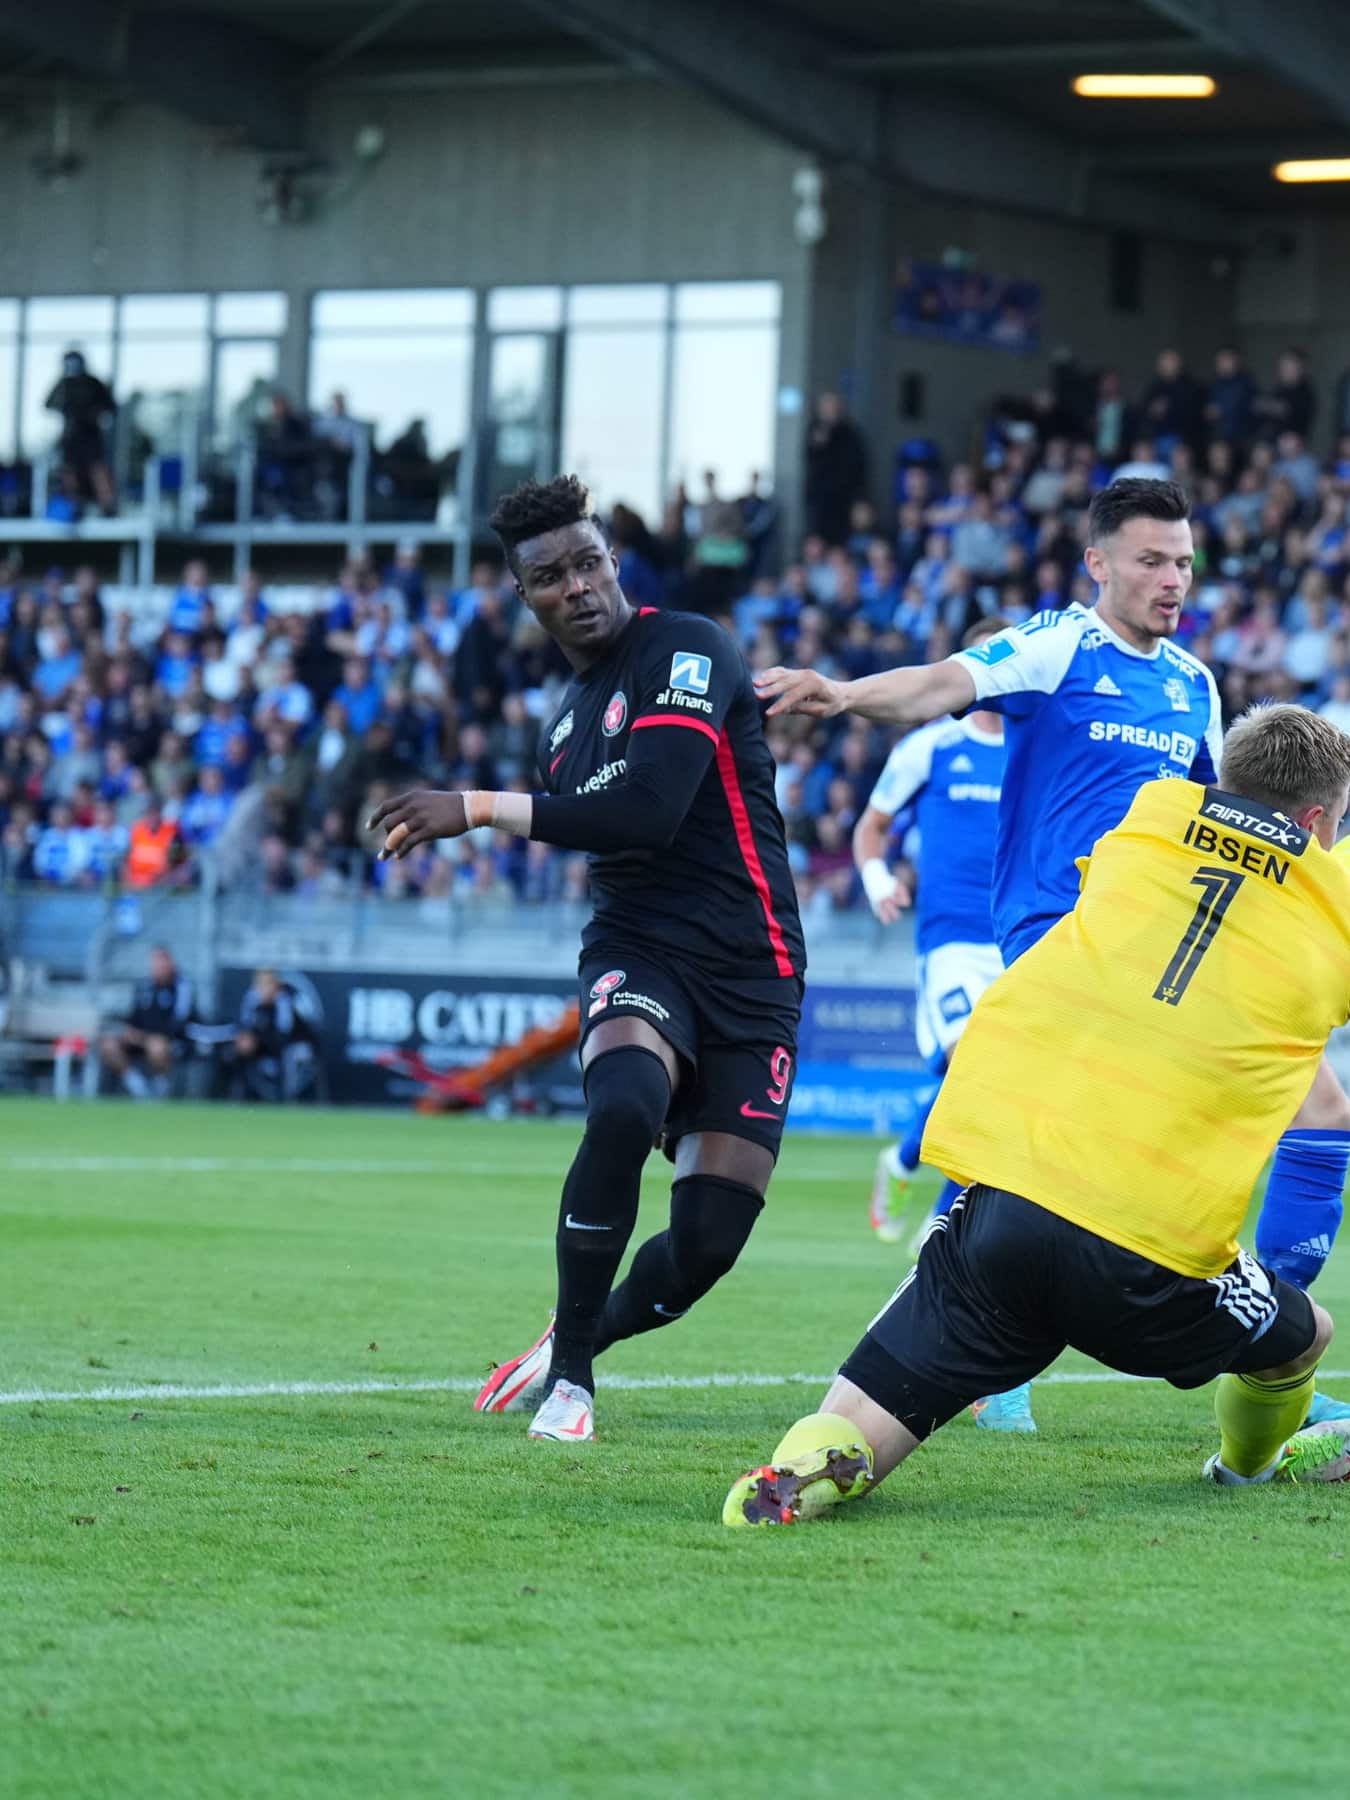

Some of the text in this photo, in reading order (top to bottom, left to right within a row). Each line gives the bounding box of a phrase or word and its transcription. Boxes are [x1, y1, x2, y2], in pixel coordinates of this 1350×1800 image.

[671, 690, 713, 714] finans
[1183, 819, 1290, 885] IBSEN
[1152, 866, 1247, 1007] 1
[766, 1046, 791, 1105] 9
